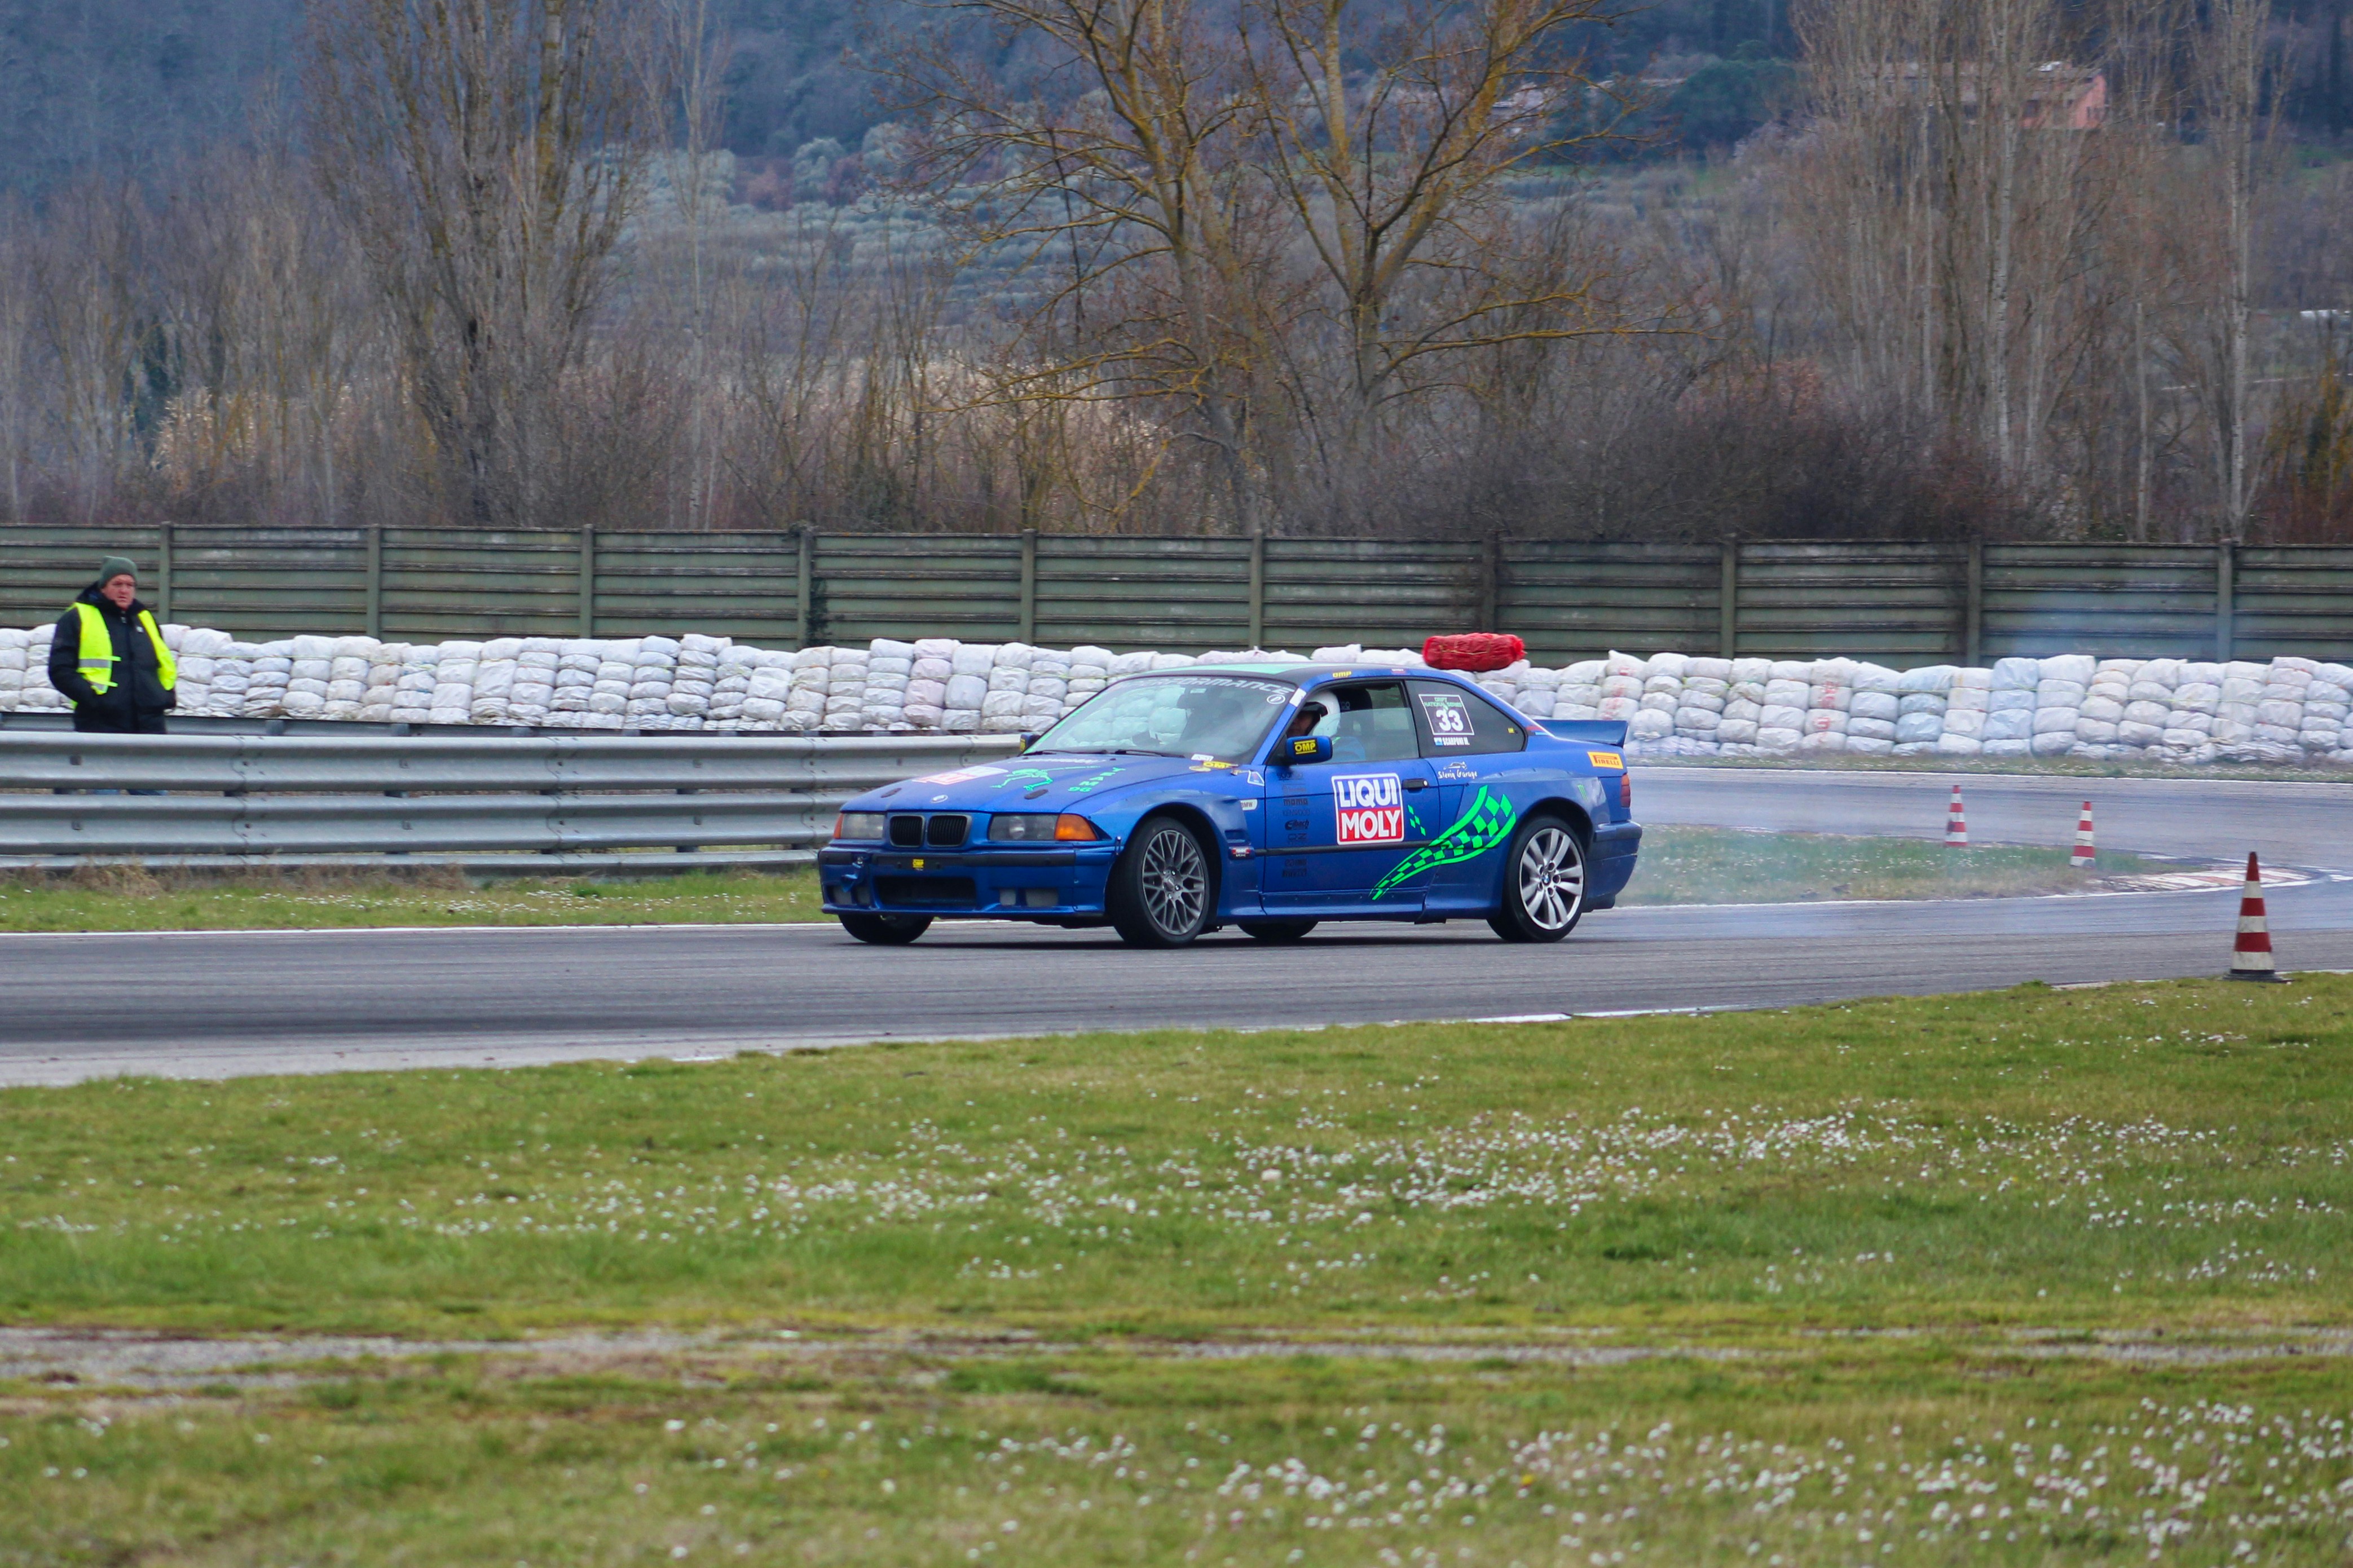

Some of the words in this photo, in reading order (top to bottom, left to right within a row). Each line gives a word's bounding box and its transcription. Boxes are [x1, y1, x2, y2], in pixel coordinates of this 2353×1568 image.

[1130, 678, 1294, 694] ERFORMANCE
[1436, 709, 1464, 732] 33
[1294, 742, 1316, 752] OMP
[1593, 754, 1620, 766] PIRELLI
[1337, 778, 1398, 808] LIQUI
[1341, 810, 1401, 840] MOLY
